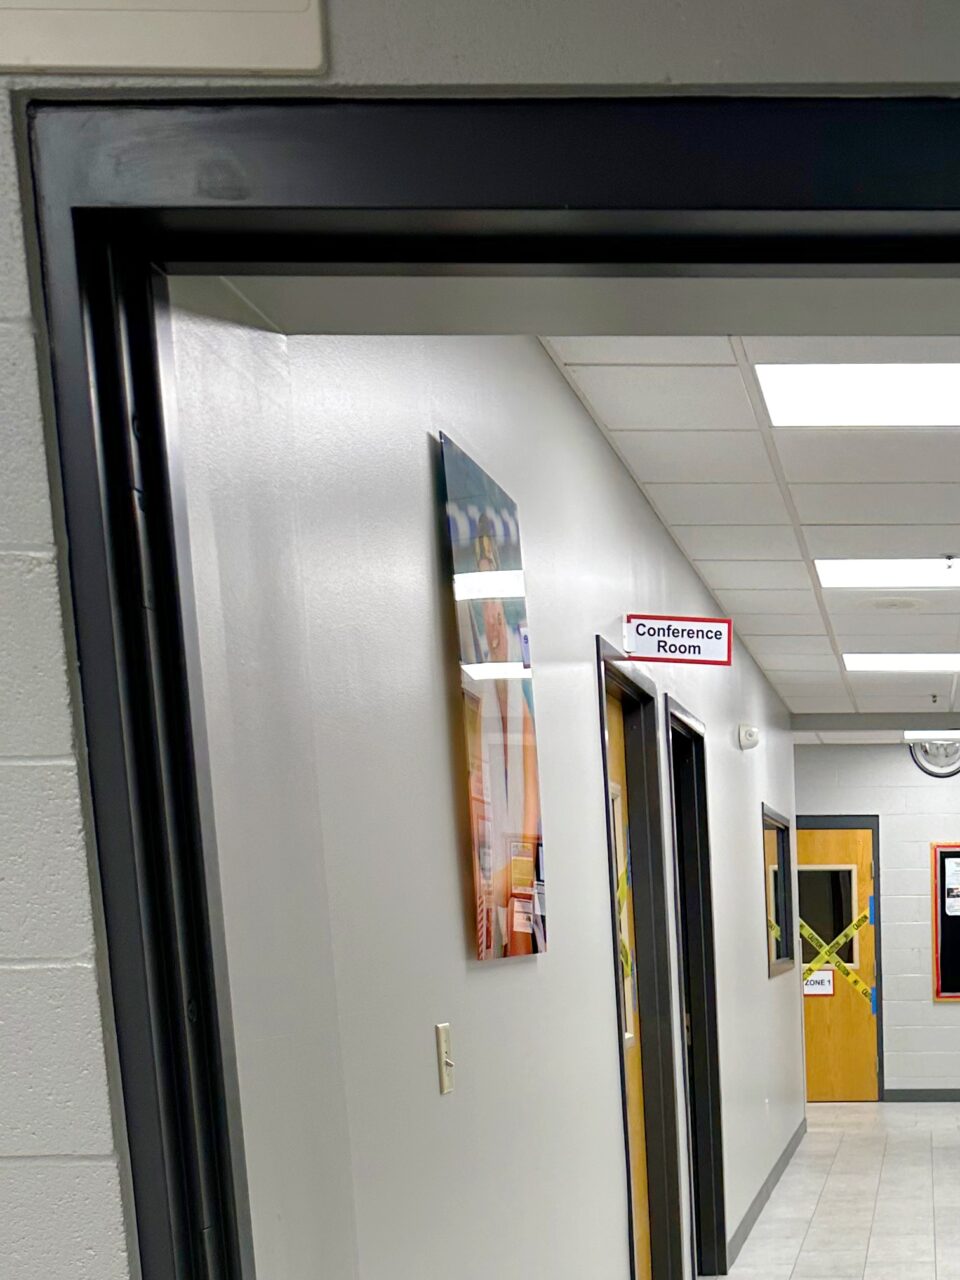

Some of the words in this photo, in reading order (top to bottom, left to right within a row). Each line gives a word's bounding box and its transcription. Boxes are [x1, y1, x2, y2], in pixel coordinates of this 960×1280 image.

[635, 623, 723, 640] Conference
[657, 640, 701, 655] Room
[853, 914, 868, 930] CAUTION
[807, 933, 823, 949] CAUTION
[825, 941, 841, 956] CAUTION
[835, 960, 849, 976] CAUTION
